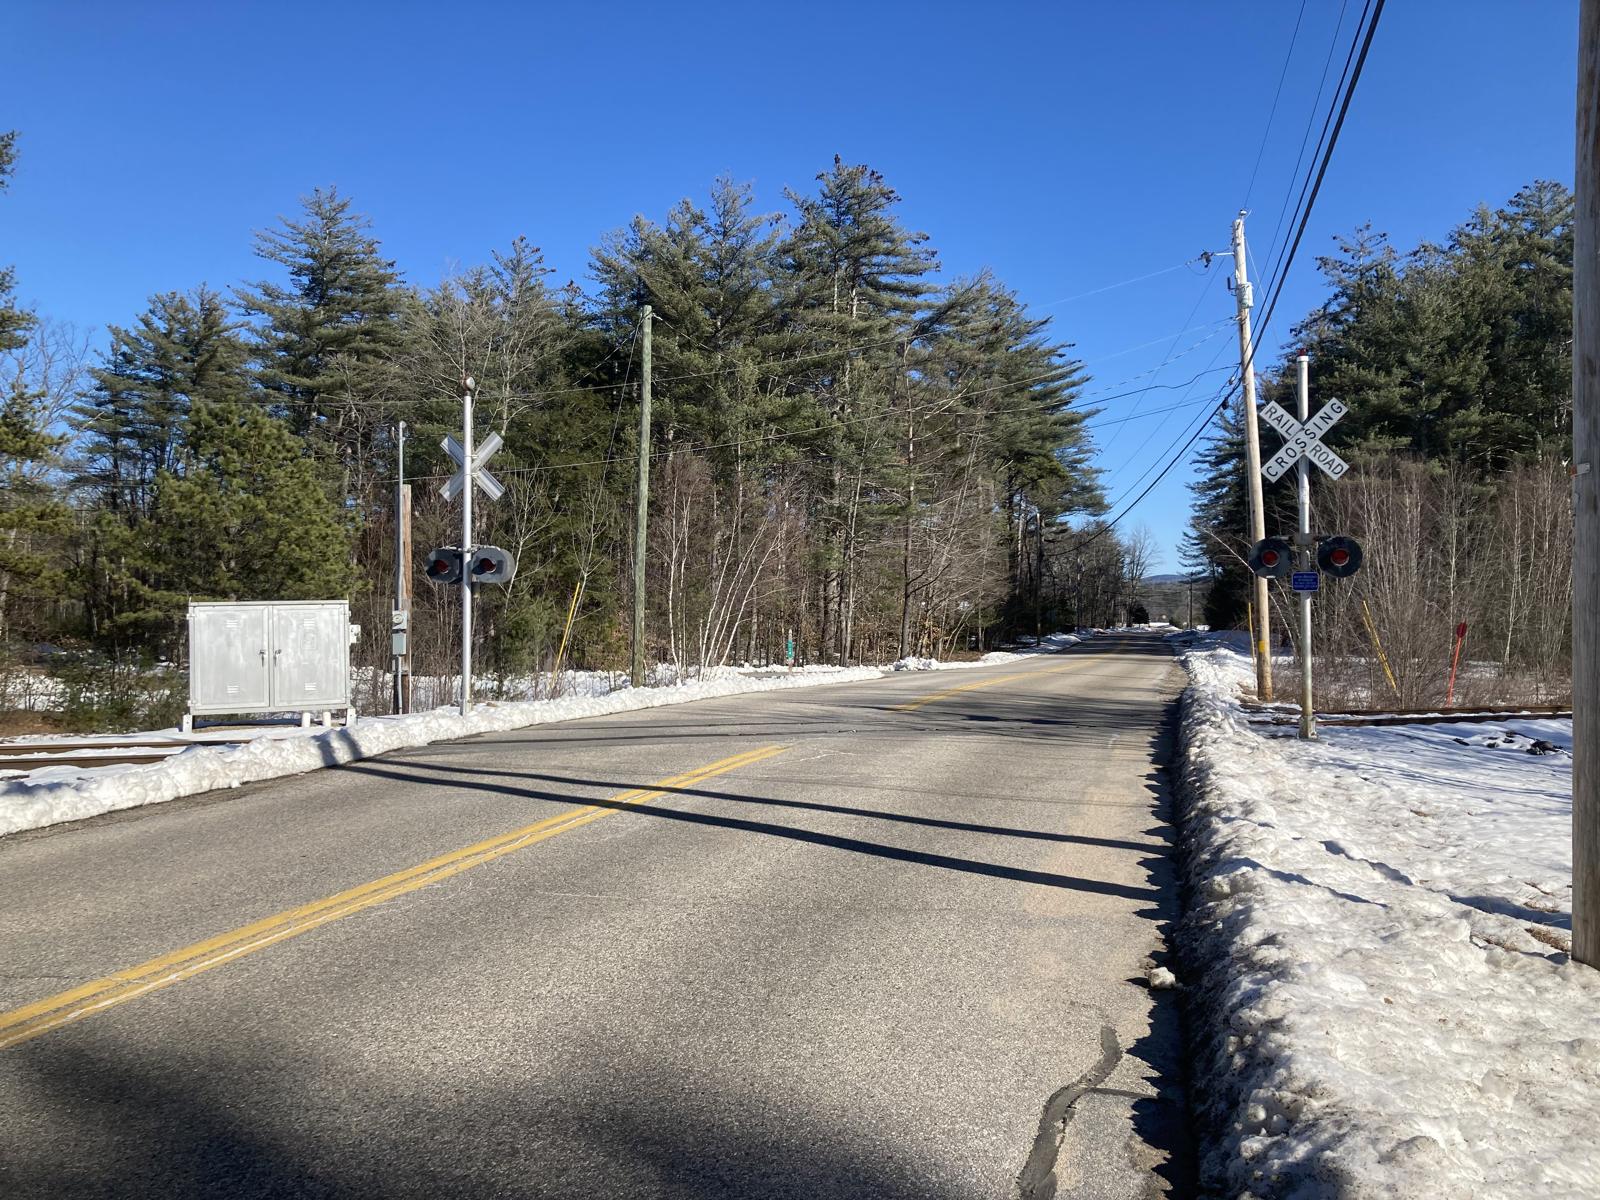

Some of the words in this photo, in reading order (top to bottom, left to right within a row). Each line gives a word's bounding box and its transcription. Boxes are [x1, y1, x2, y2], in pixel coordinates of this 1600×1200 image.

[1265, 406, 1294, 436] RAIL
[1310, 444, 1344, 475] ROAD
[1266, 402, 1343, 477] CROSSING
